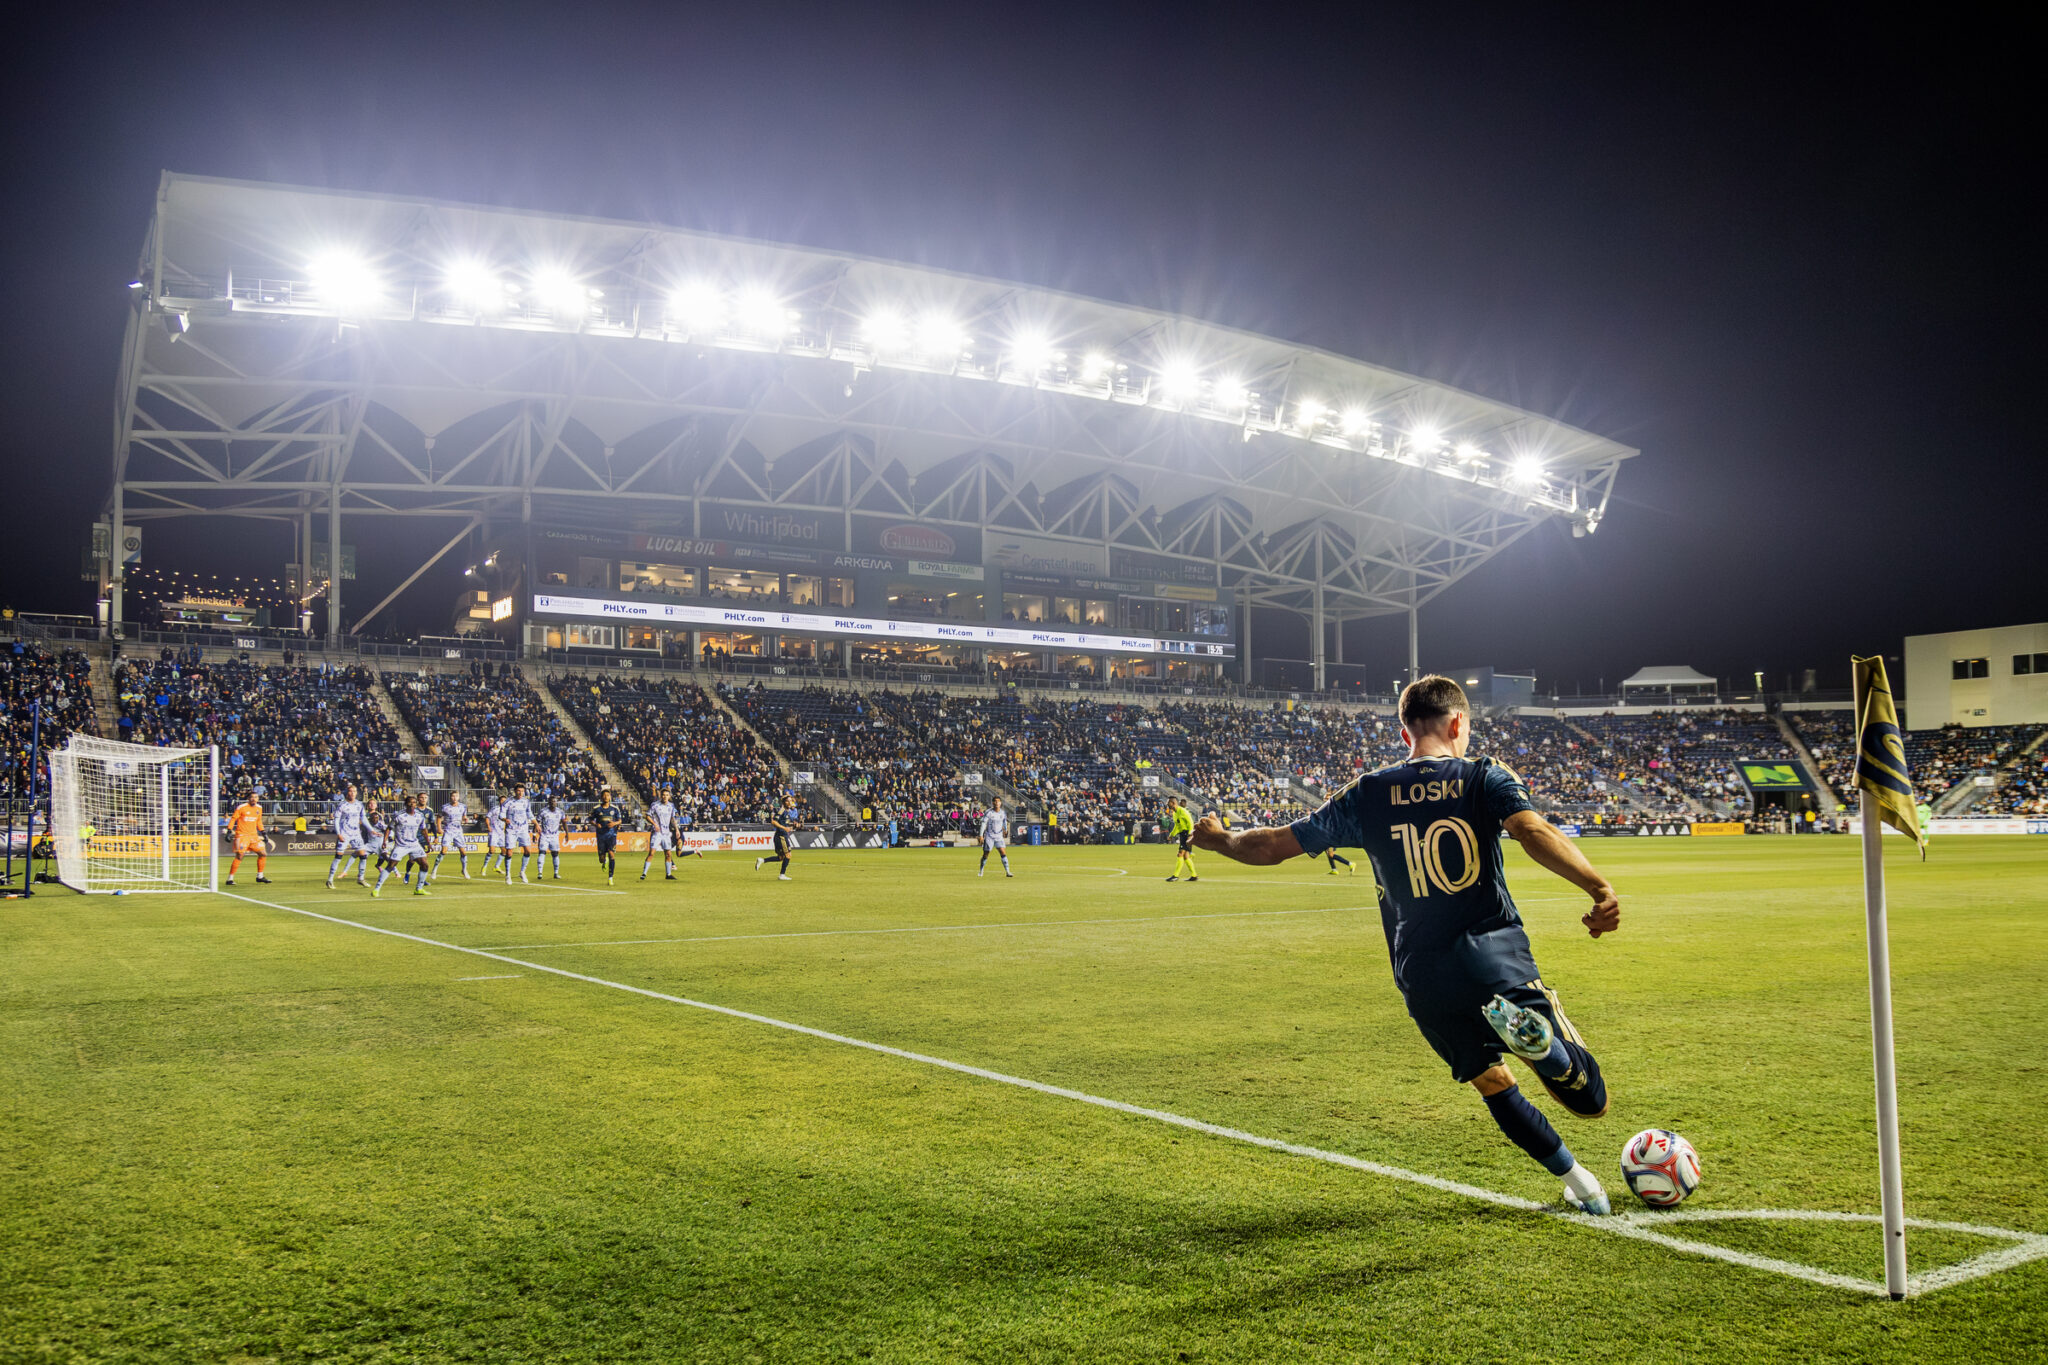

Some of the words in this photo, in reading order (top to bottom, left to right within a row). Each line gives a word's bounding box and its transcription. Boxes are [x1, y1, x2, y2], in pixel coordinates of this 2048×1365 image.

[724, 510, 819, 541] Whirlpool
[646, 537, 692, 553] LUCAS
[694, 541, 716, 556] OIL
[834, 555, 893, 570] ARKEMA
[917, 562, 947, 572] ROYAL
[183, 594, 232, 607] Heineken
[603, 603, 648, 615] PHLY.com
[724, 612, 765, 623] PHLY.com
[835, 620, 873, 630] PHLY.com
[938, 627, 973, 637] PHLY.com
[1032, 633, 1065, 643] PHLY.com
[238, 639, 256, 648] 103
[1121, 639, 1152, 649] PHLY.com
[619, 659, 633, 668] 105
[773, 667, 786, 675] 106
[920, 674, 932, 682] 107
[1390, 779, 1464, 806] ILOSKI
[562, 837, 593, 849] English
[737, 836, 772, 845] GIANT
[288, 840, 323, 852] protein
[1390, 816, 1481, 898] 10
